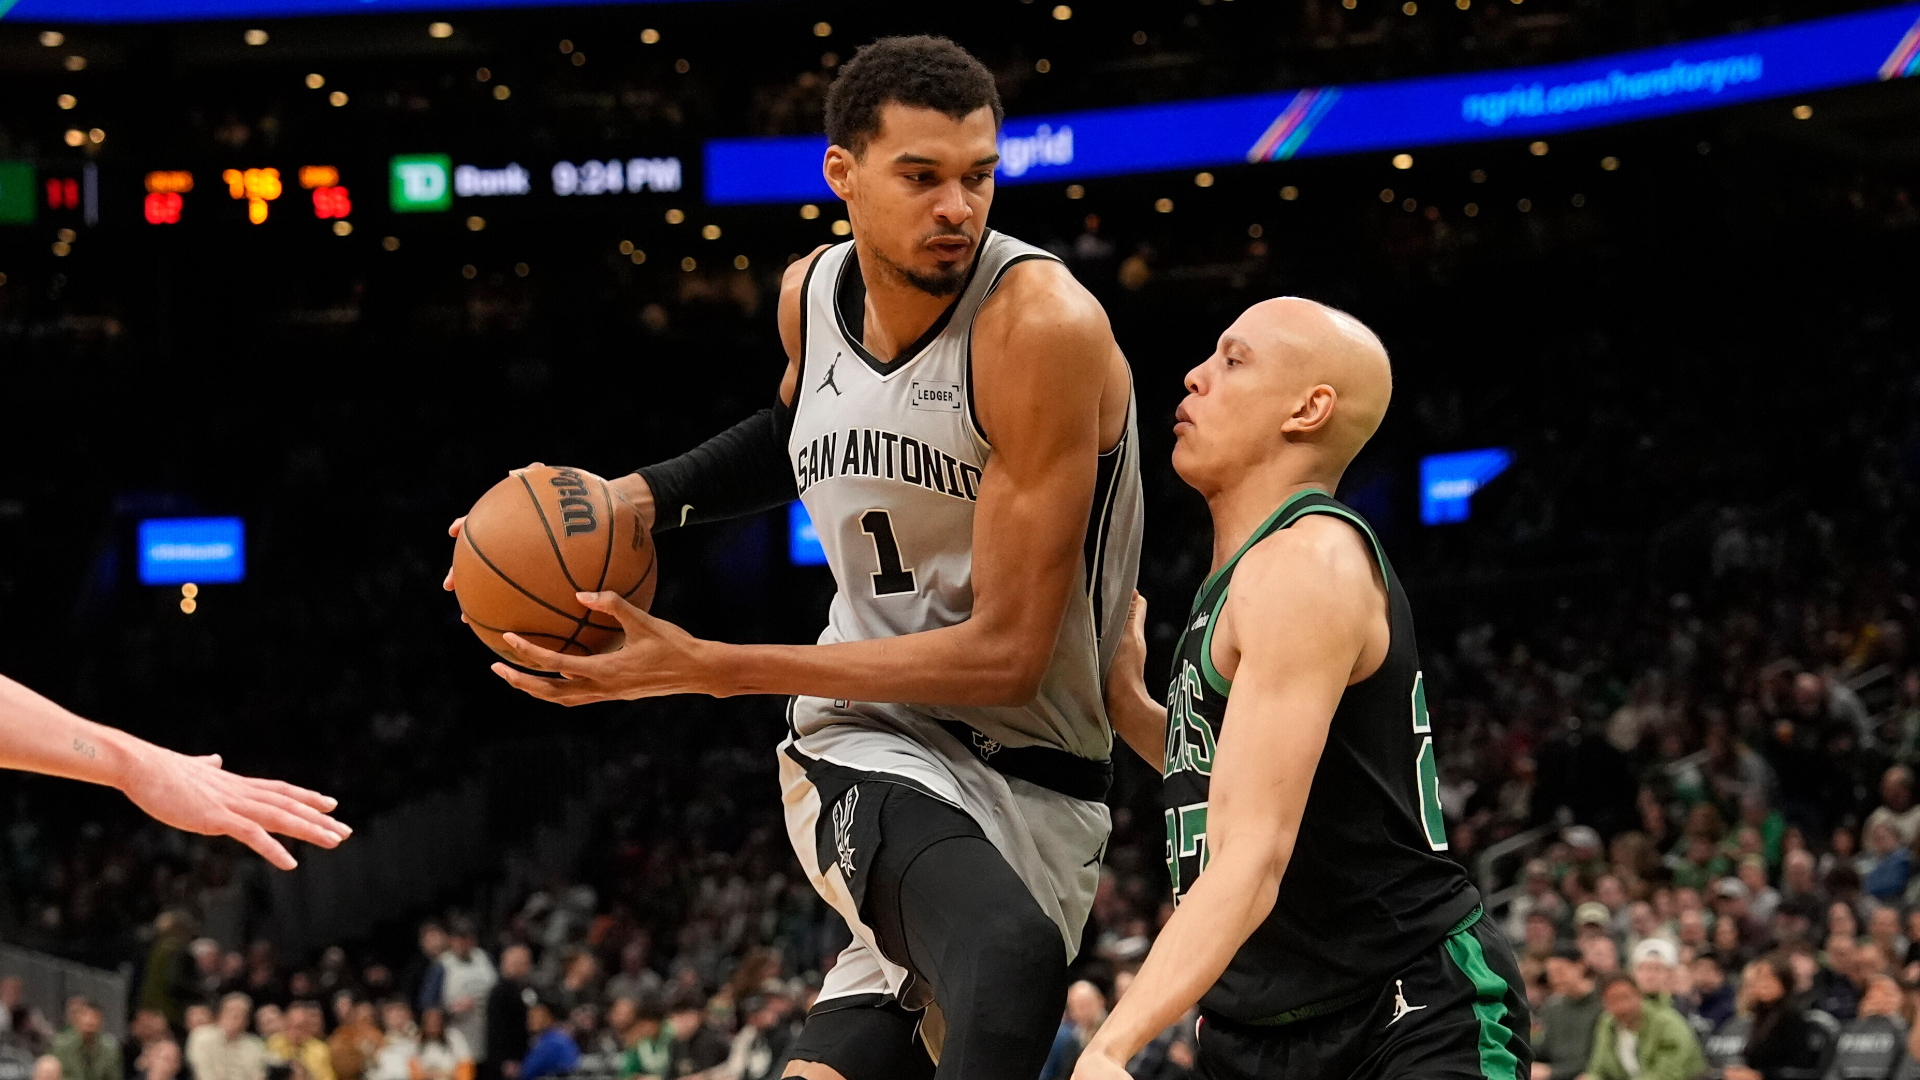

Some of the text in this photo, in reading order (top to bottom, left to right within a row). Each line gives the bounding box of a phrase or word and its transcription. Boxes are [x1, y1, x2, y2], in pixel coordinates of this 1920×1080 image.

[996, 123, 1074, 177] grid
[397, 162, 531, 202] TD Bank
[551, 157, 682, 196] 9:24 PM
[917, 388, 954, 403] LEDGER
[797, 427, 984, 504] SAN ANTONIO
[858, 508, 919, 599] 1
